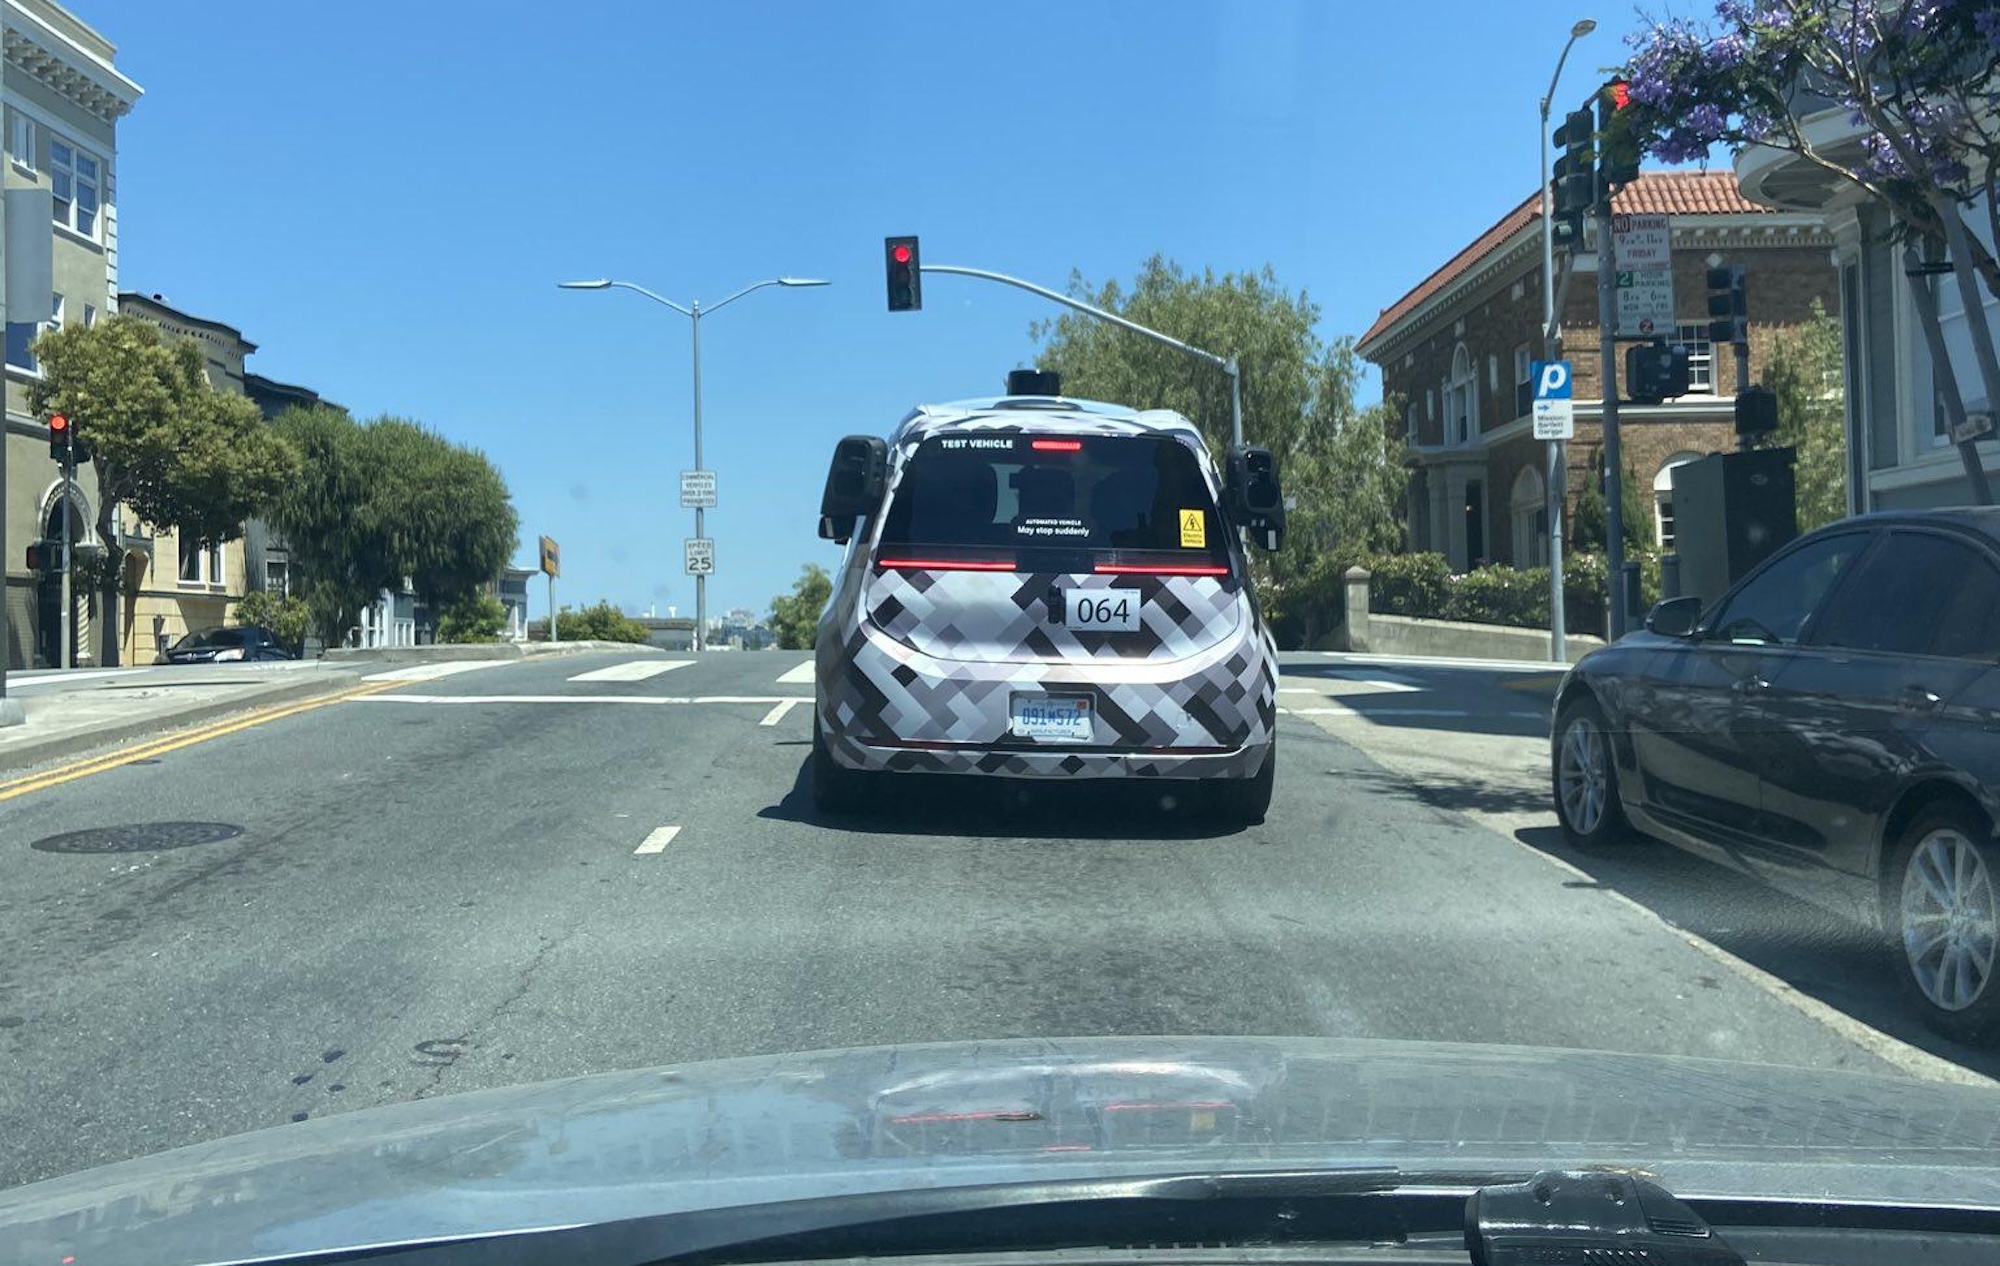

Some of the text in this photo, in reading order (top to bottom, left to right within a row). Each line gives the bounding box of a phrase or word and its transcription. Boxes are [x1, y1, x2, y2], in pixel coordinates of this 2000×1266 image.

[1614, 217, 1667, 232] NO PARKING
[1627, 249, 1657, 259] FRIDAY
[1619, 272, 1630, 286] 2
[941, 439, 1013, 449] TEST VEHICLE
[1017, 526, 1090, 538] May stop suddenly
[688, 557, 712, 570] 25
[1077, 597, 1131, 623] 064
